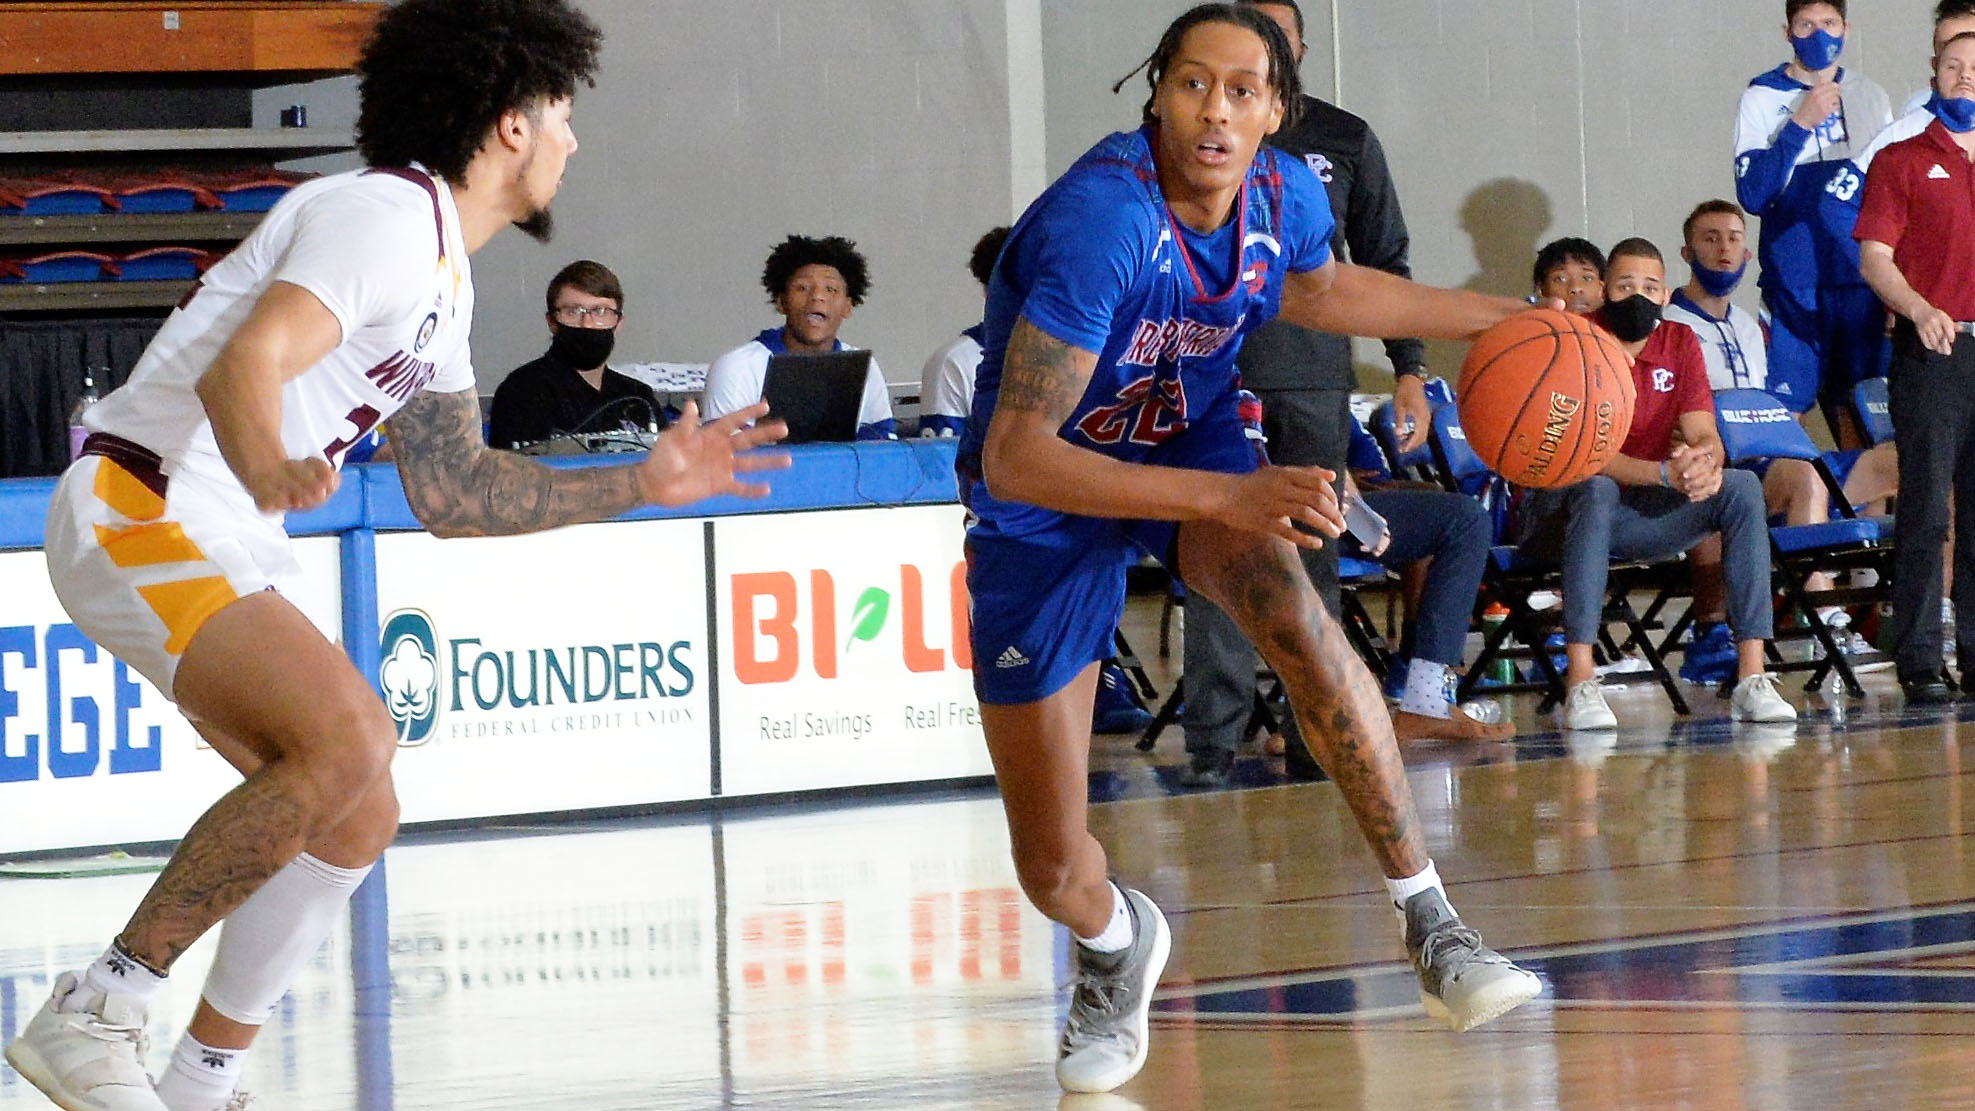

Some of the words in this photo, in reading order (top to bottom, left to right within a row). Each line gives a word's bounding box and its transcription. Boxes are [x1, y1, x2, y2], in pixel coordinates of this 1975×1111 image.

[1825, 167, 1860, 202] 33
[1652, 367, 1675, 393] PC
[1074, 372, 1190, 446] 22
[1520, 391, 1580, 482] ALDING
[448, 637, 695, 712] FOUNDERS
[450, 718, 541, 740] FEDERAL
[550, 712, 624, 732] CREDIT
[633, 707, 696, 727] UNION
[759, 713, 798, 741] Real
[804, 711, 873, 740] Savings
[905, 703, 942, 730] Real
